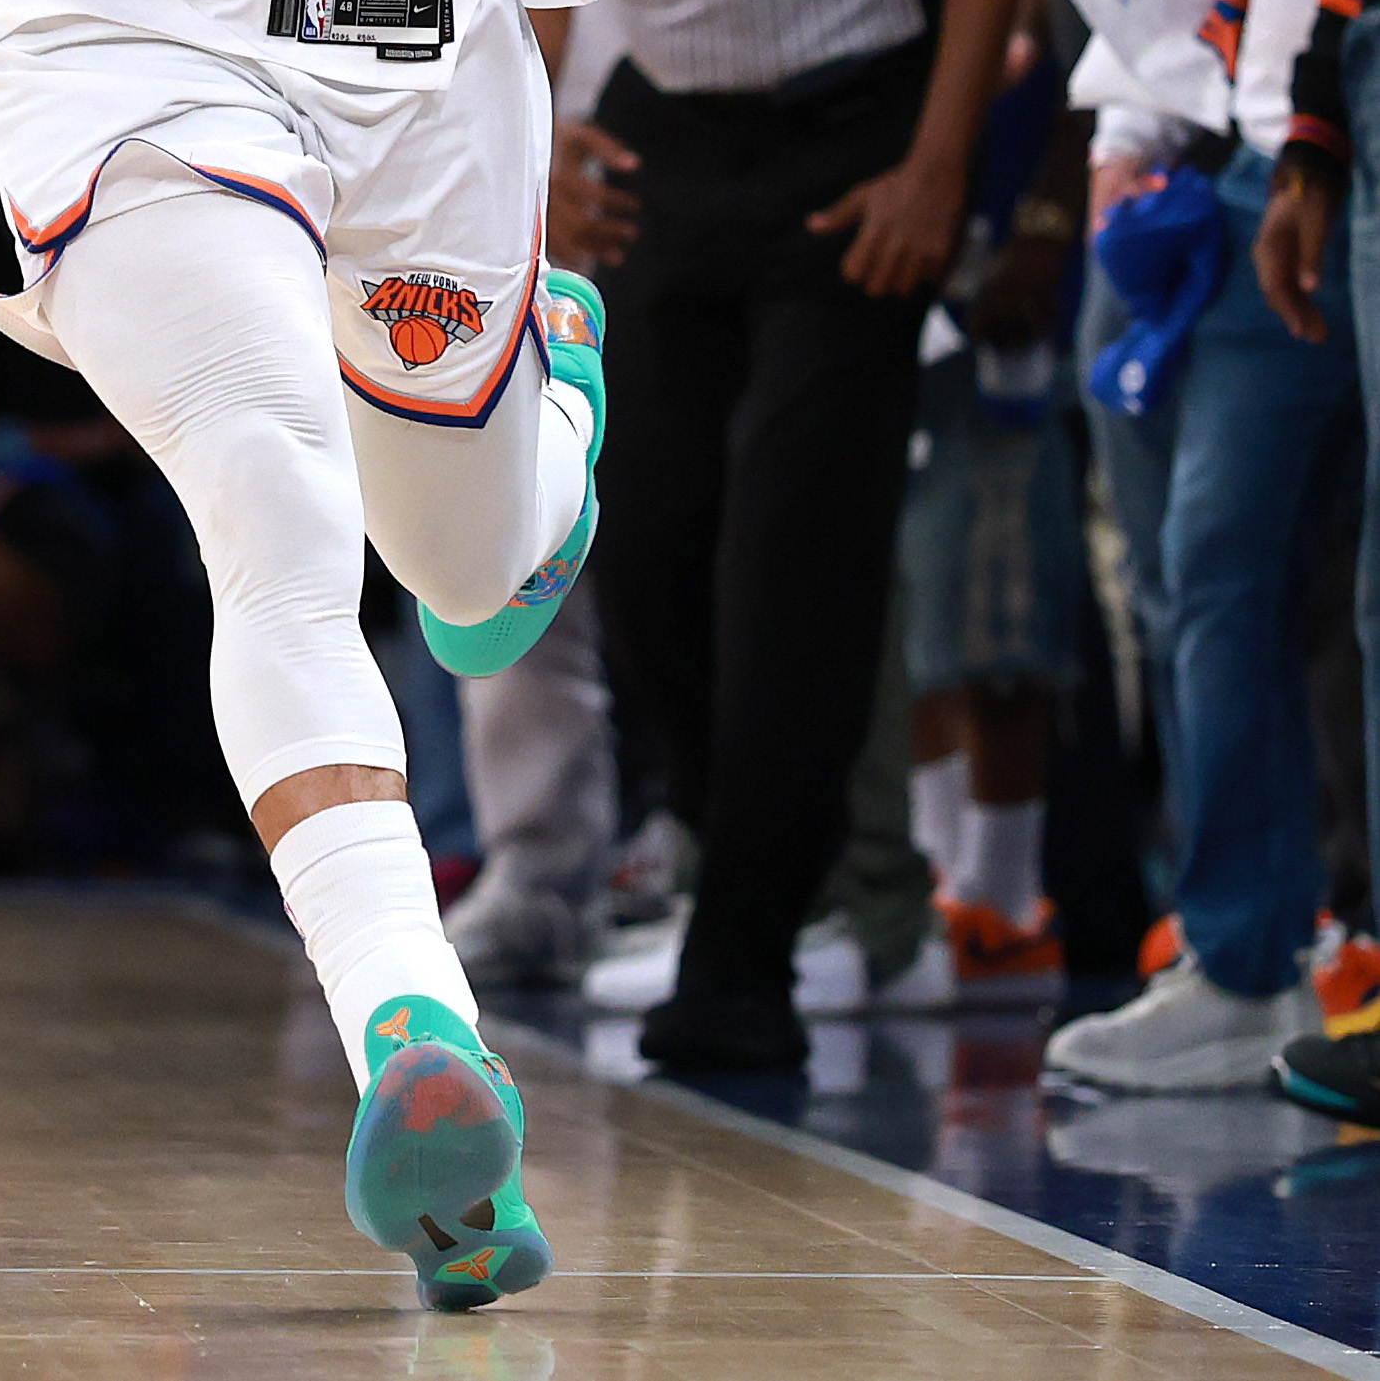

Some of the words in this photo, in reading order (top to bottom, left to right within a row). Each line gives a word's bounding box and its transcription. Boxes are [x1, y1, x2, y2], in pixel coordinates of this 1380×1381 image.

[339, 1, 353, 12] 48
[407, 273, 431, 284] NEW
[433, 274, 458, 292] YORK
[360, 277, 484, 334] KNICKS
